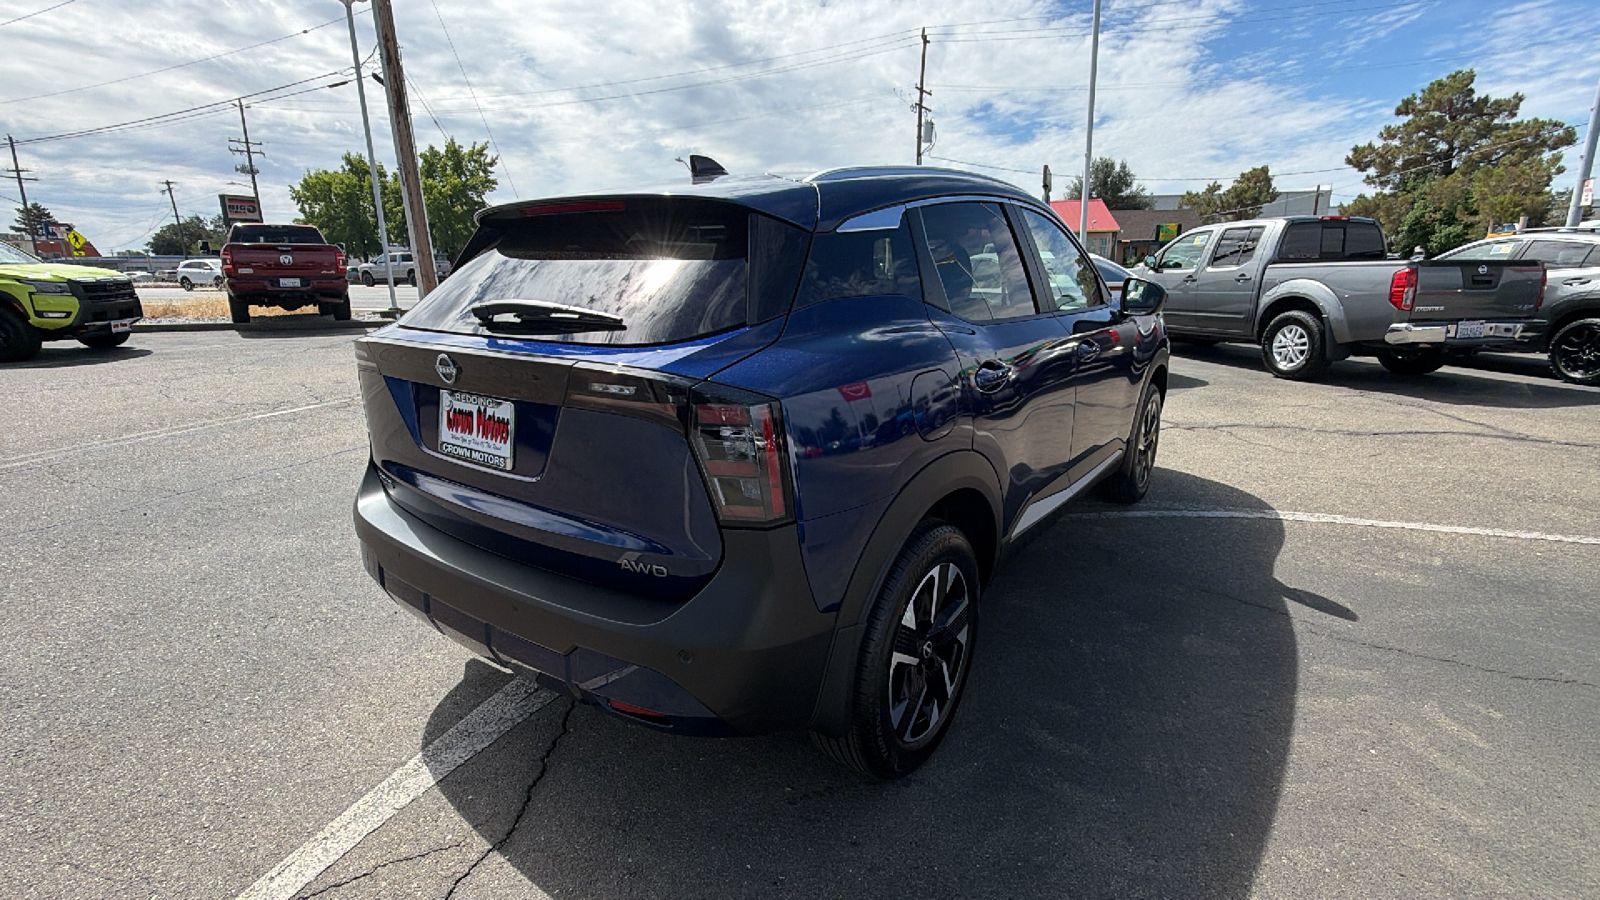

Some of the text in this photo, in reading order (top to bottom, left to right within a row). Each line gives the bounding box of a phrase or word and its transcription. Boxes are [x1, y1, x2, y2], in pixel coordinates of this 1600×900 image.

[455, 393, 493, 407] REDDING
[446, 406, 510, 444] Crown Motors
[443, 444, 505, 467] CROWN MOTORS
[621, 559, 667, 577] AWD
